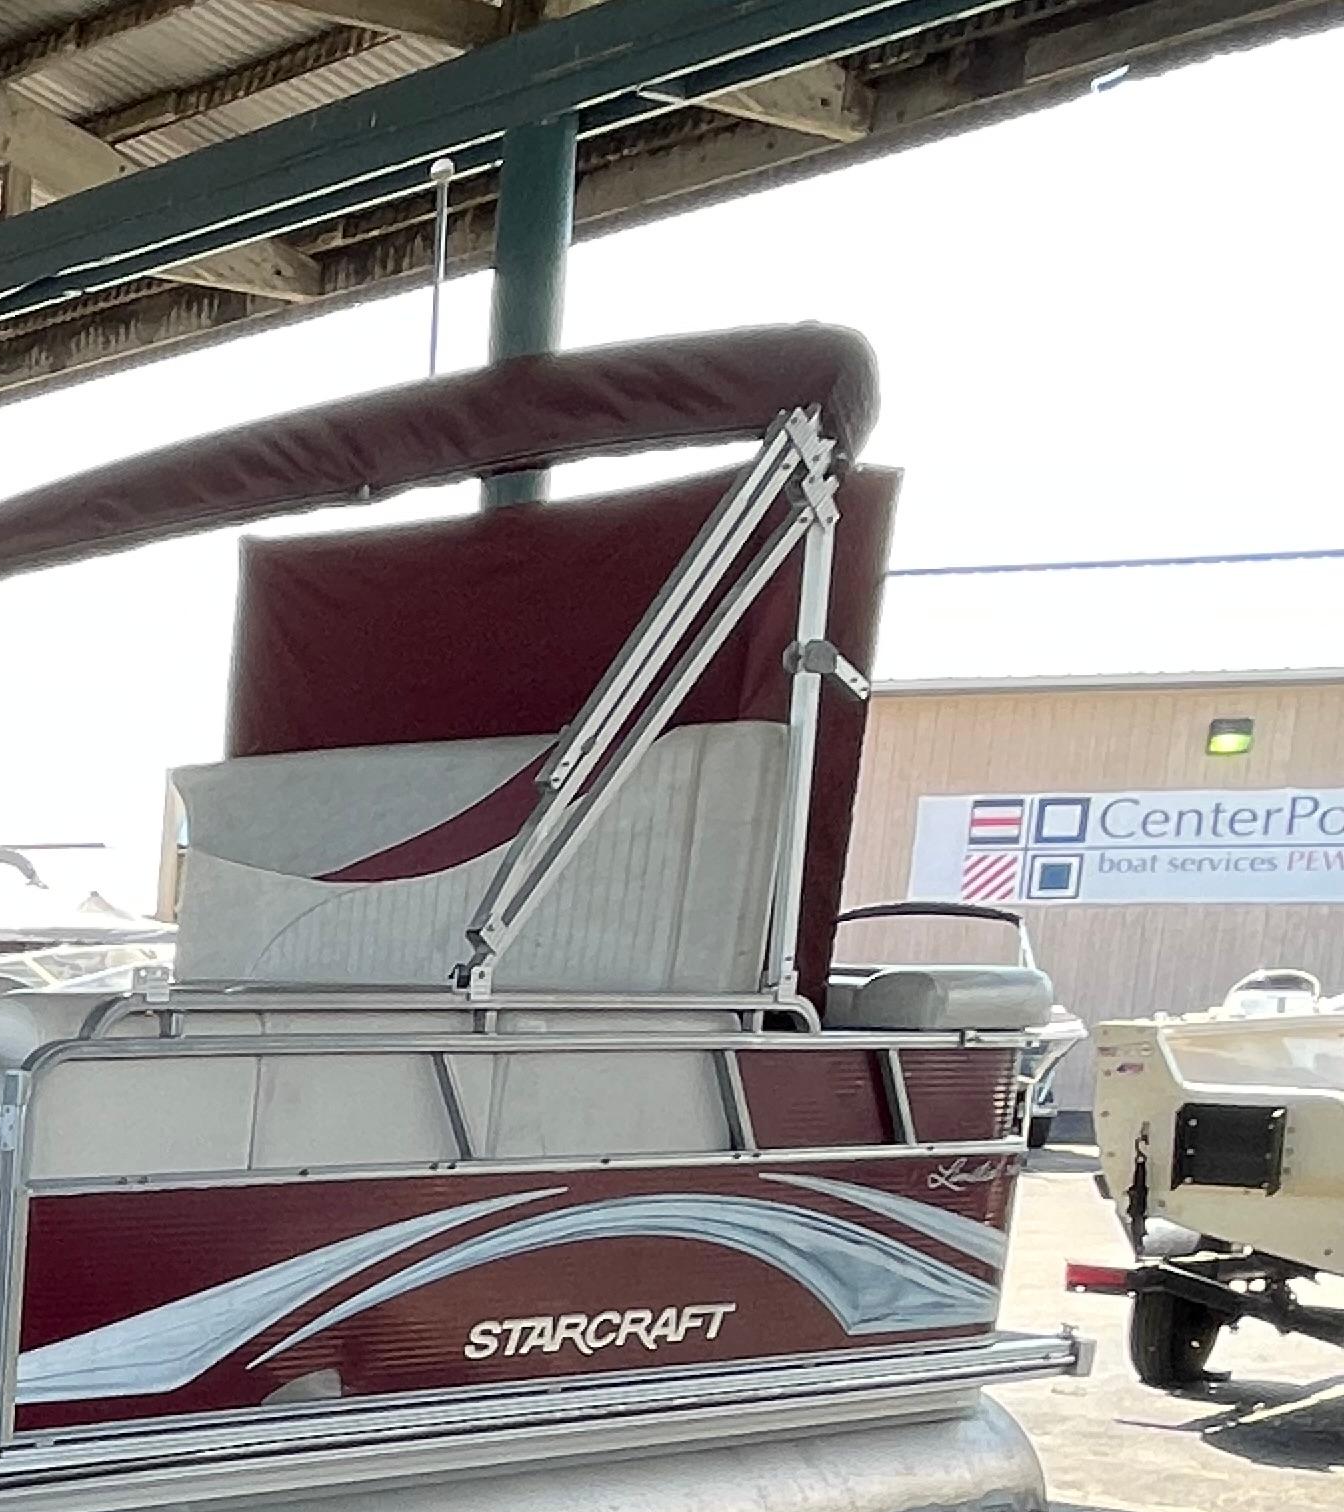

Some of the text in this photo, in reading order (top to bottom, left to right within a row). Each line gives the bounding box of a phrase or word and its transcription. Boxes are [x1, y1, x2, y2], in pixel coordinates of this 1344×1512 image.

[1098, 851, 1158, 873] boat
[1167, 850, 1277, 873] services
[464, 1302, 736, 1360] STARCRAFT
